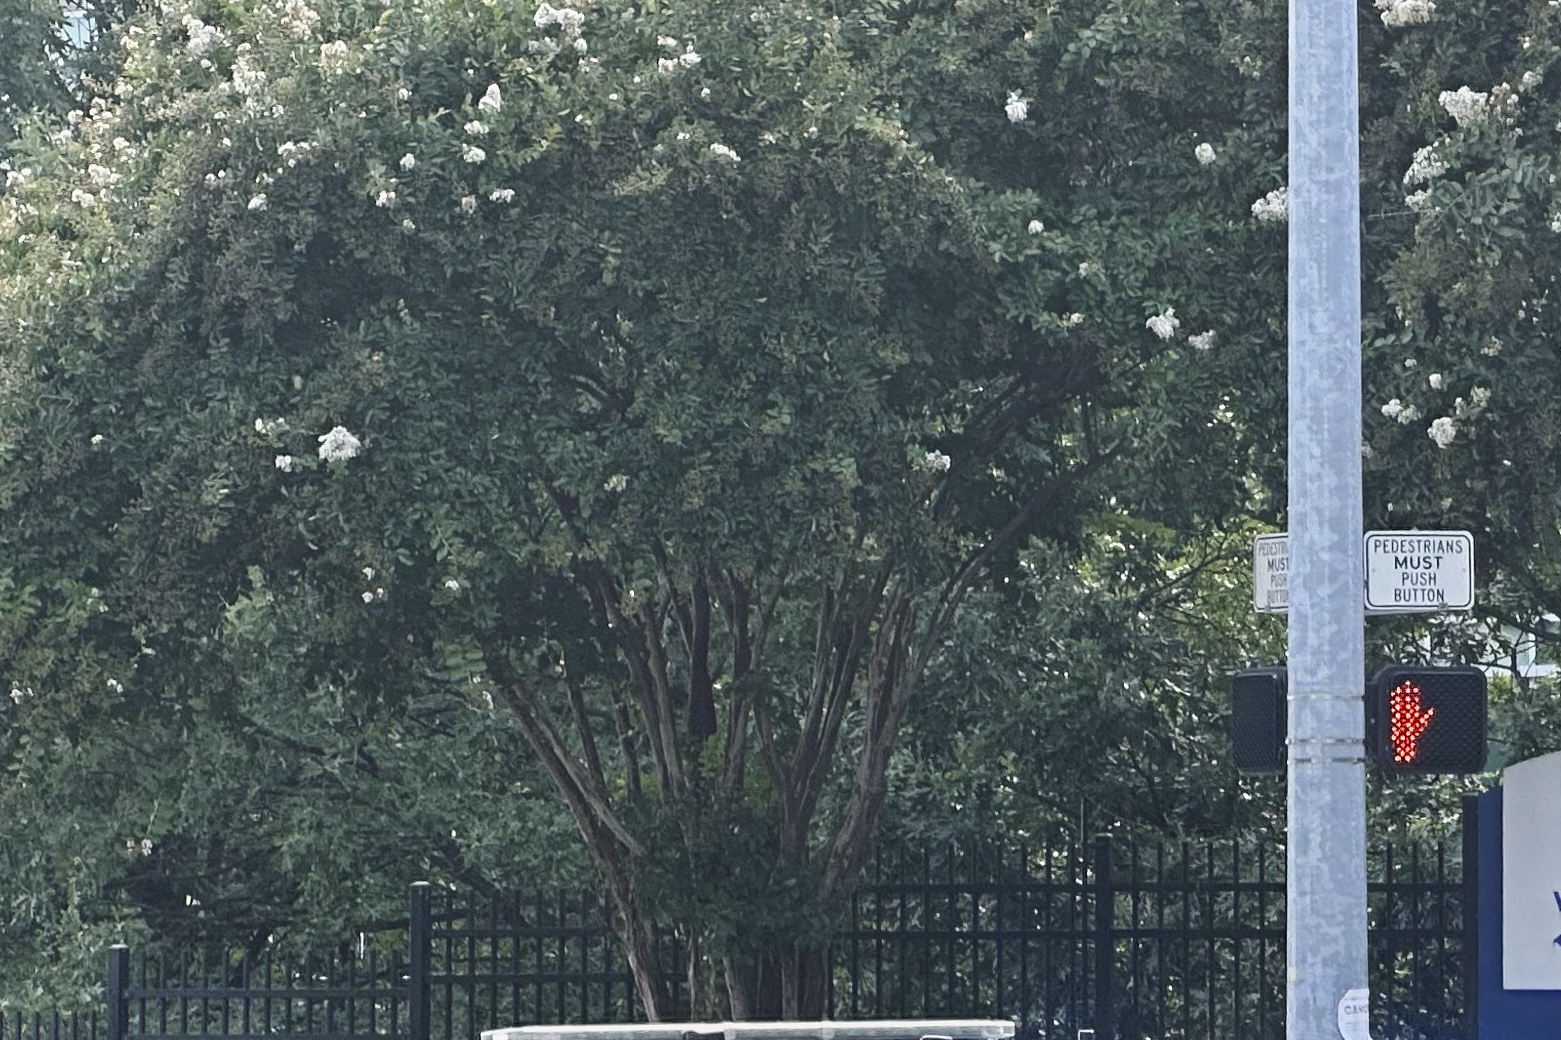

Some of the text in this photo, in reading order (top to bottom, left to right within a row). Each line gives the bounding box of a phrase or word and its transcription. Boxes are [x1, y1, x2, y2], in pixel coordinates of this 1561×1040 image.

[1373, 539, 1464, 554] PEDESTRIANS
[1393, 555, 1443, 570] MUST
[1270, 573, 1288, 588] PUSH
[1401, 571, 1437, 587] PUSH
[1393, 587, 1445, 603] BUTTON
